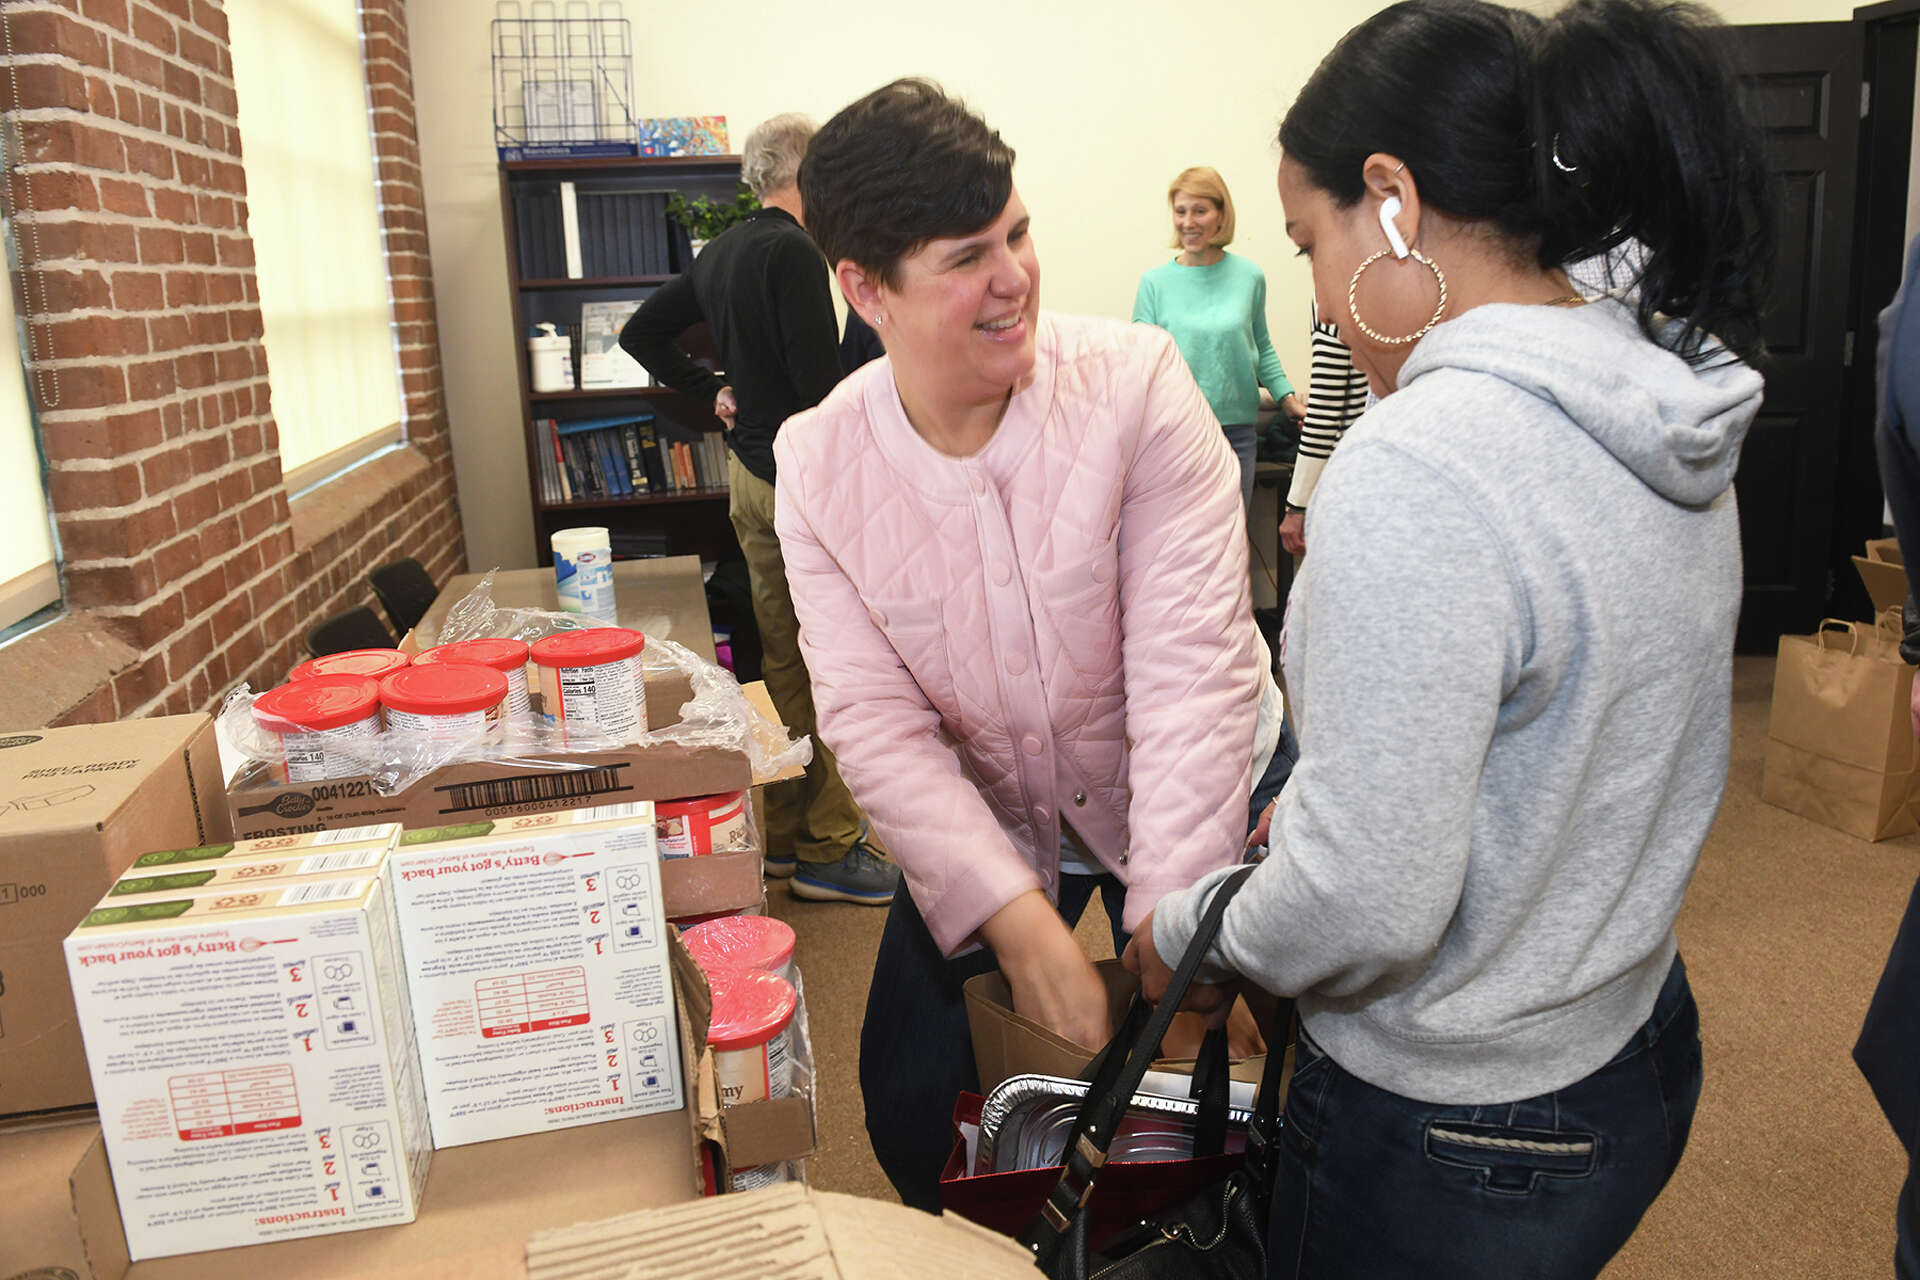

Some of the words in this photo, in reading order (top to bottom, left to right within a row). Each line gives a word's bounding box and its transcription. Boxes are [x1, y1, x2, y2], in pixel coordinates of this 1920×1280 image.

[309, 752, 325, 761] 140
[312, 781, 377, 801] 0041221
[243, 823, 327, 840] FROSTING
[437, 862, 467, 875] your
[471, 858, 492, 871] got
[494, 855, 540, 870] Betty's
[402, 868, 434, 881] back
[20, 884, 47, 898] 000
[586, 878, 596, 891] 3
[590, 910, 600, 923] 2
[120, 947, 153, 961] your
[157, 944, 181, 958] got
[184, 941, 236, 956] Betty's
[595, 941, 602, 955] 1
[79, 953, 116, 967] back
[289, 967, 302, 982] 3
[295, 1003, 308, 1018] 2
[604, 1030, 614, 1043] 3
[304, 1037, 312, 1052] 1
[607, 1054, 617, 1067] 2
[612, 1078, 619, 1091] 1
[721, 1084, 744, 1101] my
[545, 1096, 624, 1114] Instructions:
[319, 1134, 331, 1149] 3
[324, 1161, 336, 1175] 2
[330, 1188, 338, 1201] 1
[255, 1207, 345, 1225] Instructions:
